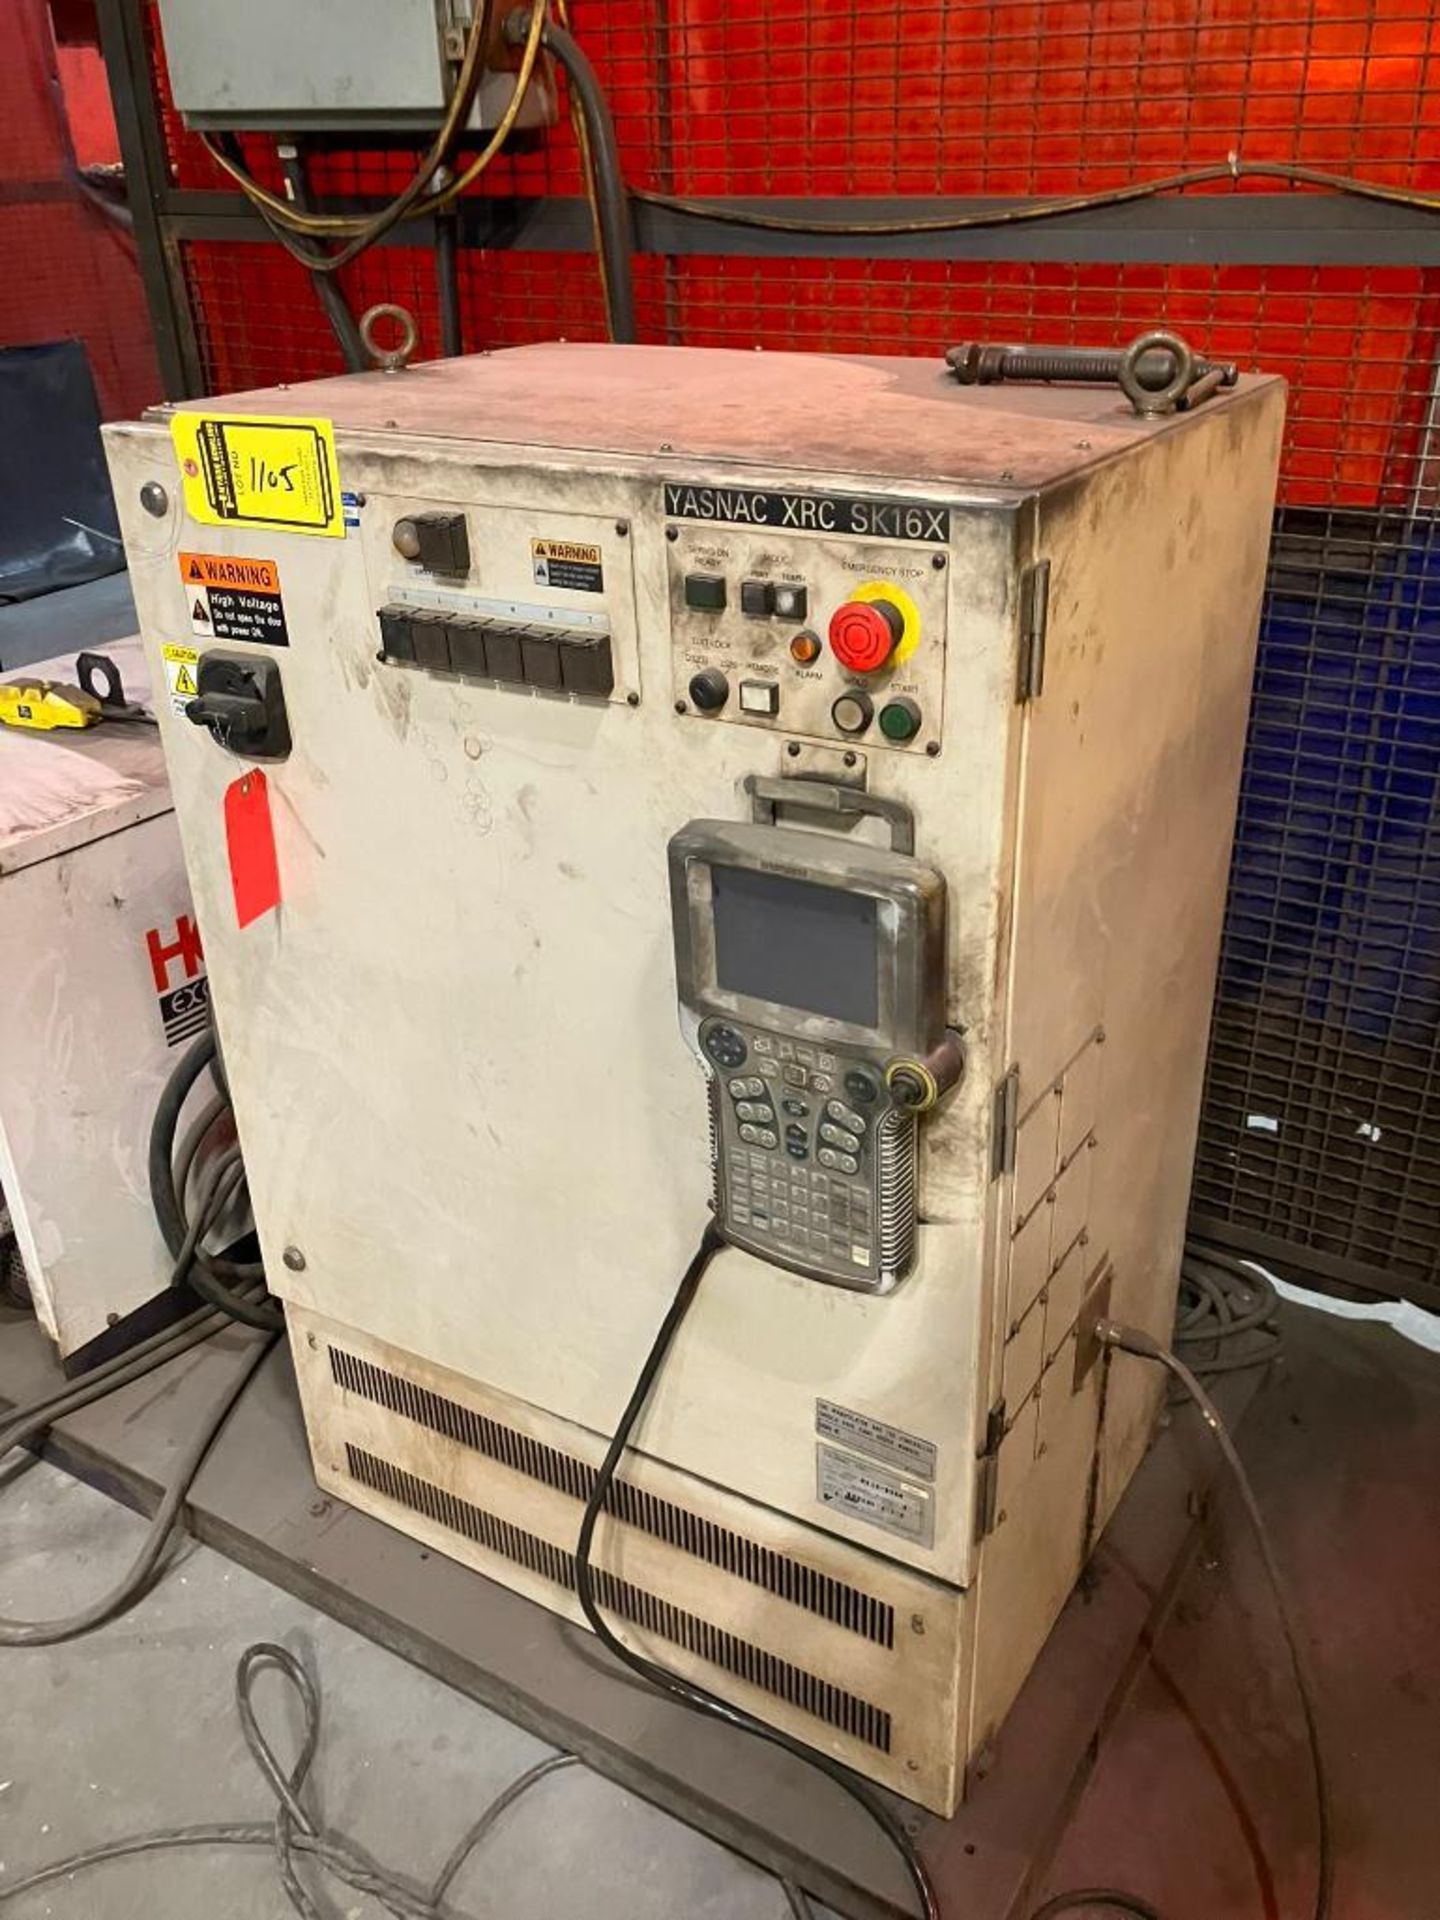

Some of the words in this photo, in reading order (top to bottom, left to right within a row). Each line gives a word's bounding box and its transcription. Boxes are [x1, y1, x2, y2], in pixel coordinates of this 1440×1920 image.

[250, 457, 298, 493] 1105
[667, 486, 768, 523] YASNAC
[781, 496, 836, 530] XRC
[850, 503, 946, 540] SK16X
[548, 543, 597, 562] WARNING
[205, 560, 272, 587] WARNING
[898, 567, 924, 579] STOP
[210, 593, 235, 607] High
[239, 597, 279, 613] Voltage
[213, 609, 223, 619] Do
